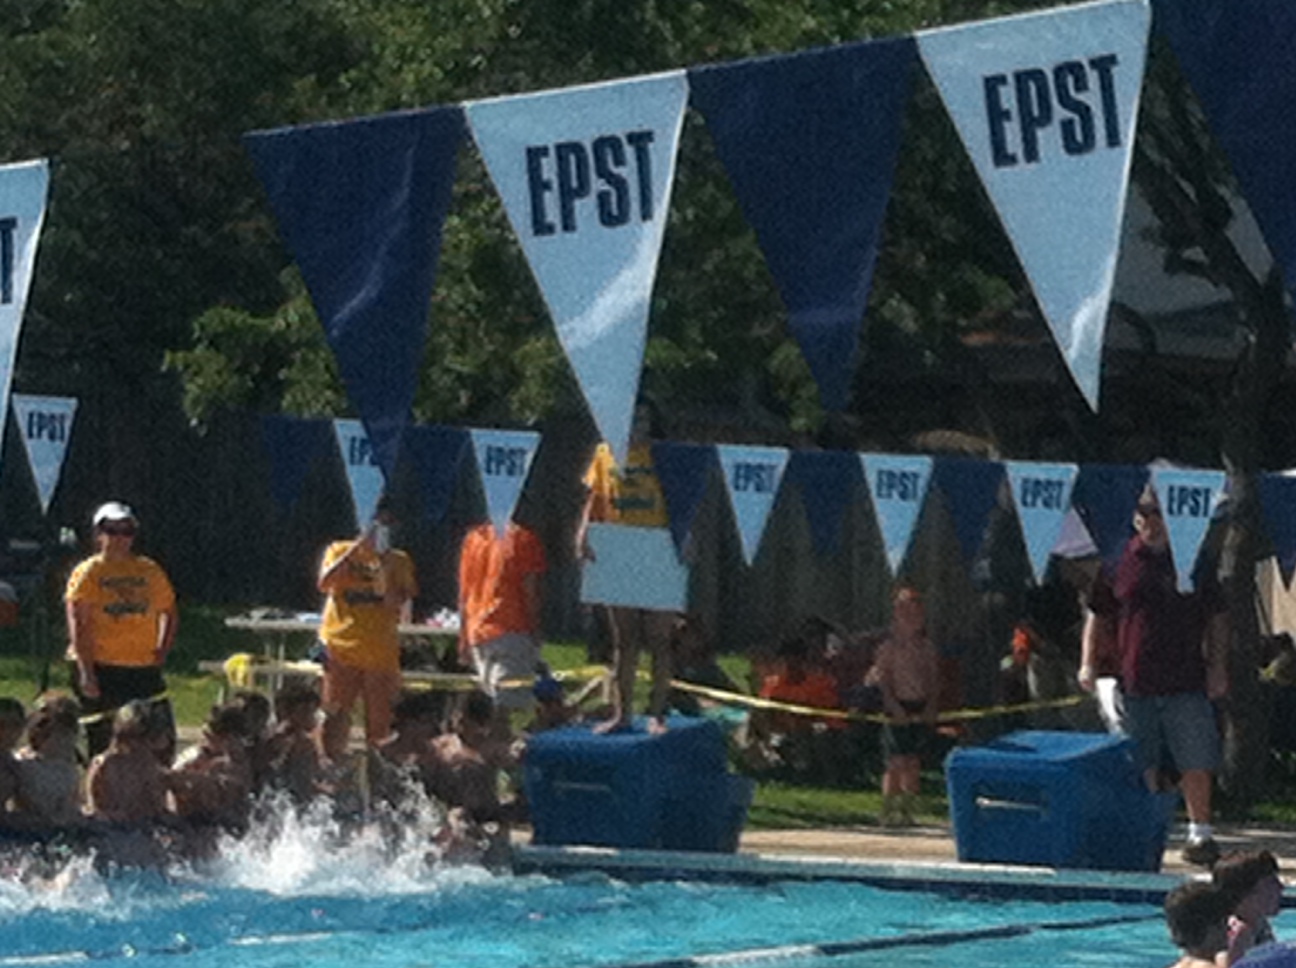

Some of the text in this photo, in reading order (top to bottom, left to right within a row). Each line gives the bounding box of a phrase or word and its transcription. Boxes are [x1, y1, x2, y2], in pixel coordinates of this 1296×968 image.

[982, 54, 1121, 168] EPST
[525, 130, 656, 237] EPST
[27, 411, 66, 442] EPST
[485, 446, 527, 476] EPST
[734, 463, 778, 494] EPST
[876, 470, 921, 501] EPST
[1021, 478, 1066, 510] EPST
[1167, 485, 1212, 518] EPST
